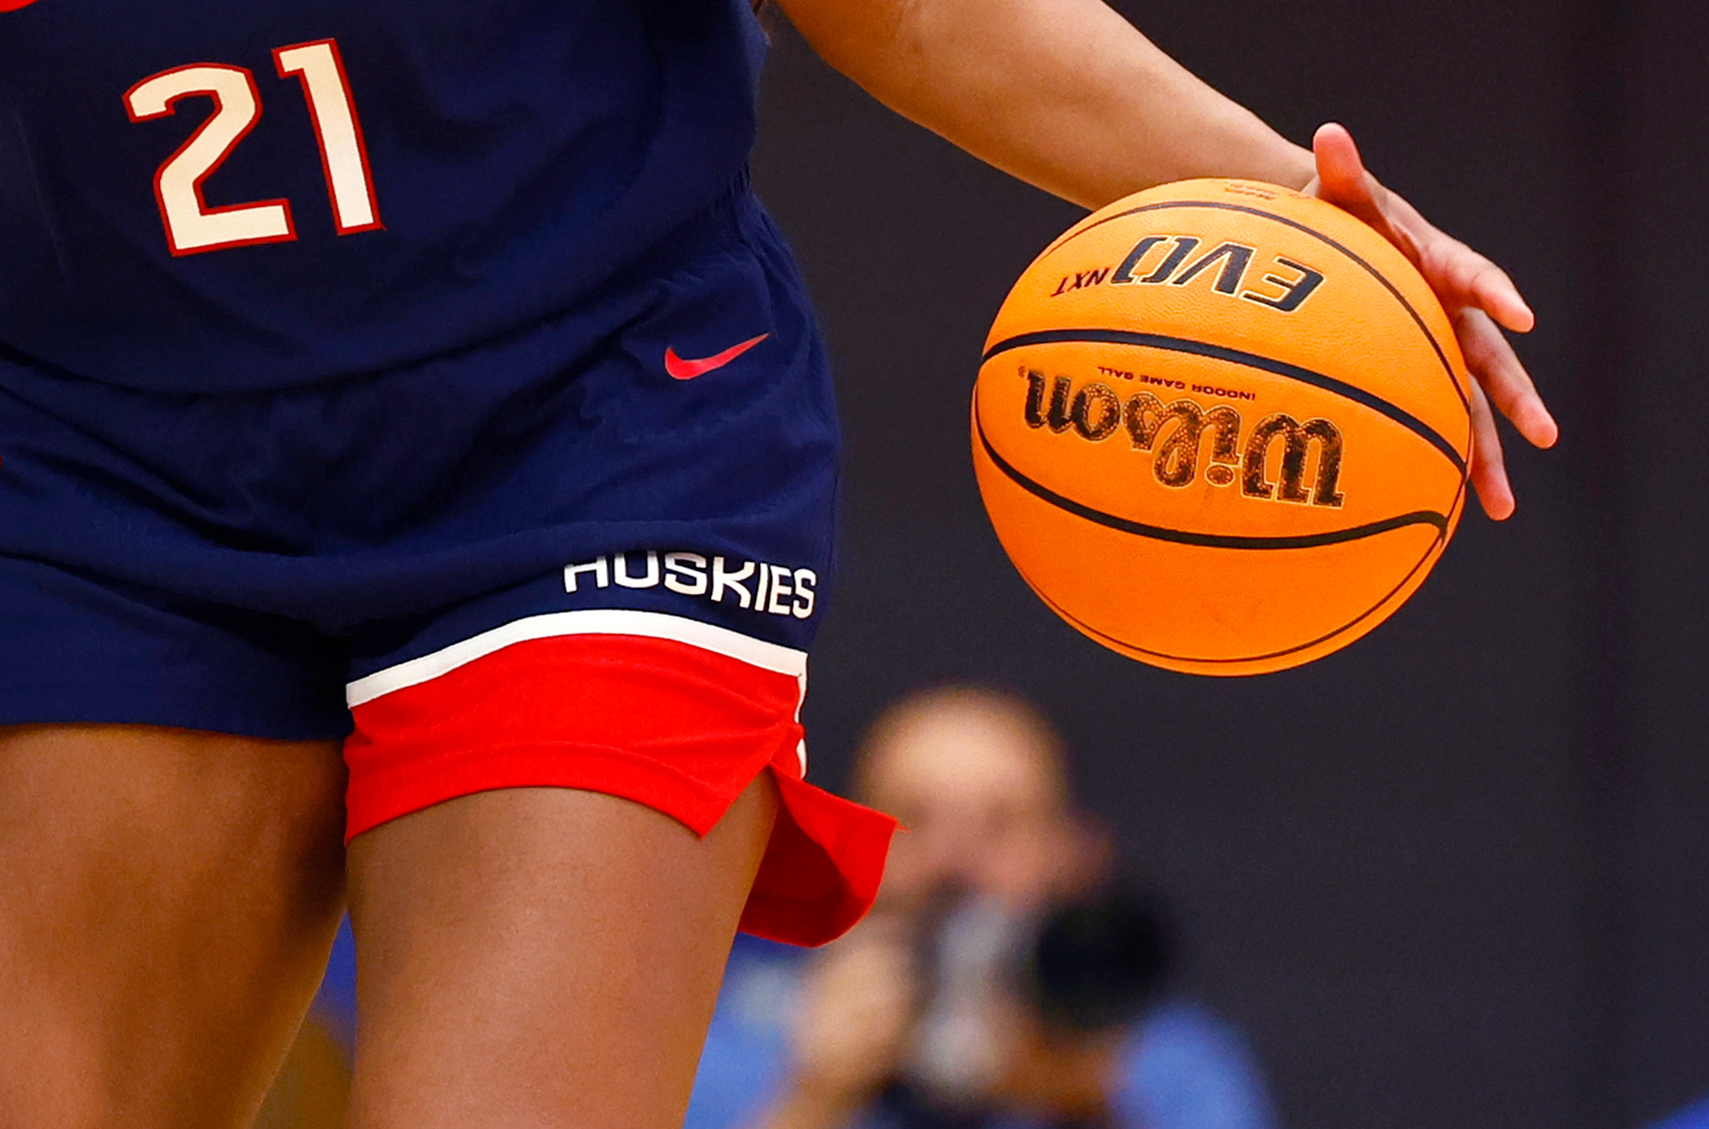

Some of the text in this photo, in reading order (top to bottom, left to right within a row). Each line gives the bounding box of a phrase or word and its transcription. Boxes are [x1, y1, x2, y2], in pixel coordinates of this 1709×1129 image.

[121, 37, 387, 257] 21
[1050, 234, 1327, 313] EVO NXT
[1097, 366, 1256, 401] INDOOR GAME BALL
[1023, 368, 1346, 510] Wilson
[563, 550, 816, 619] HUSKIES
